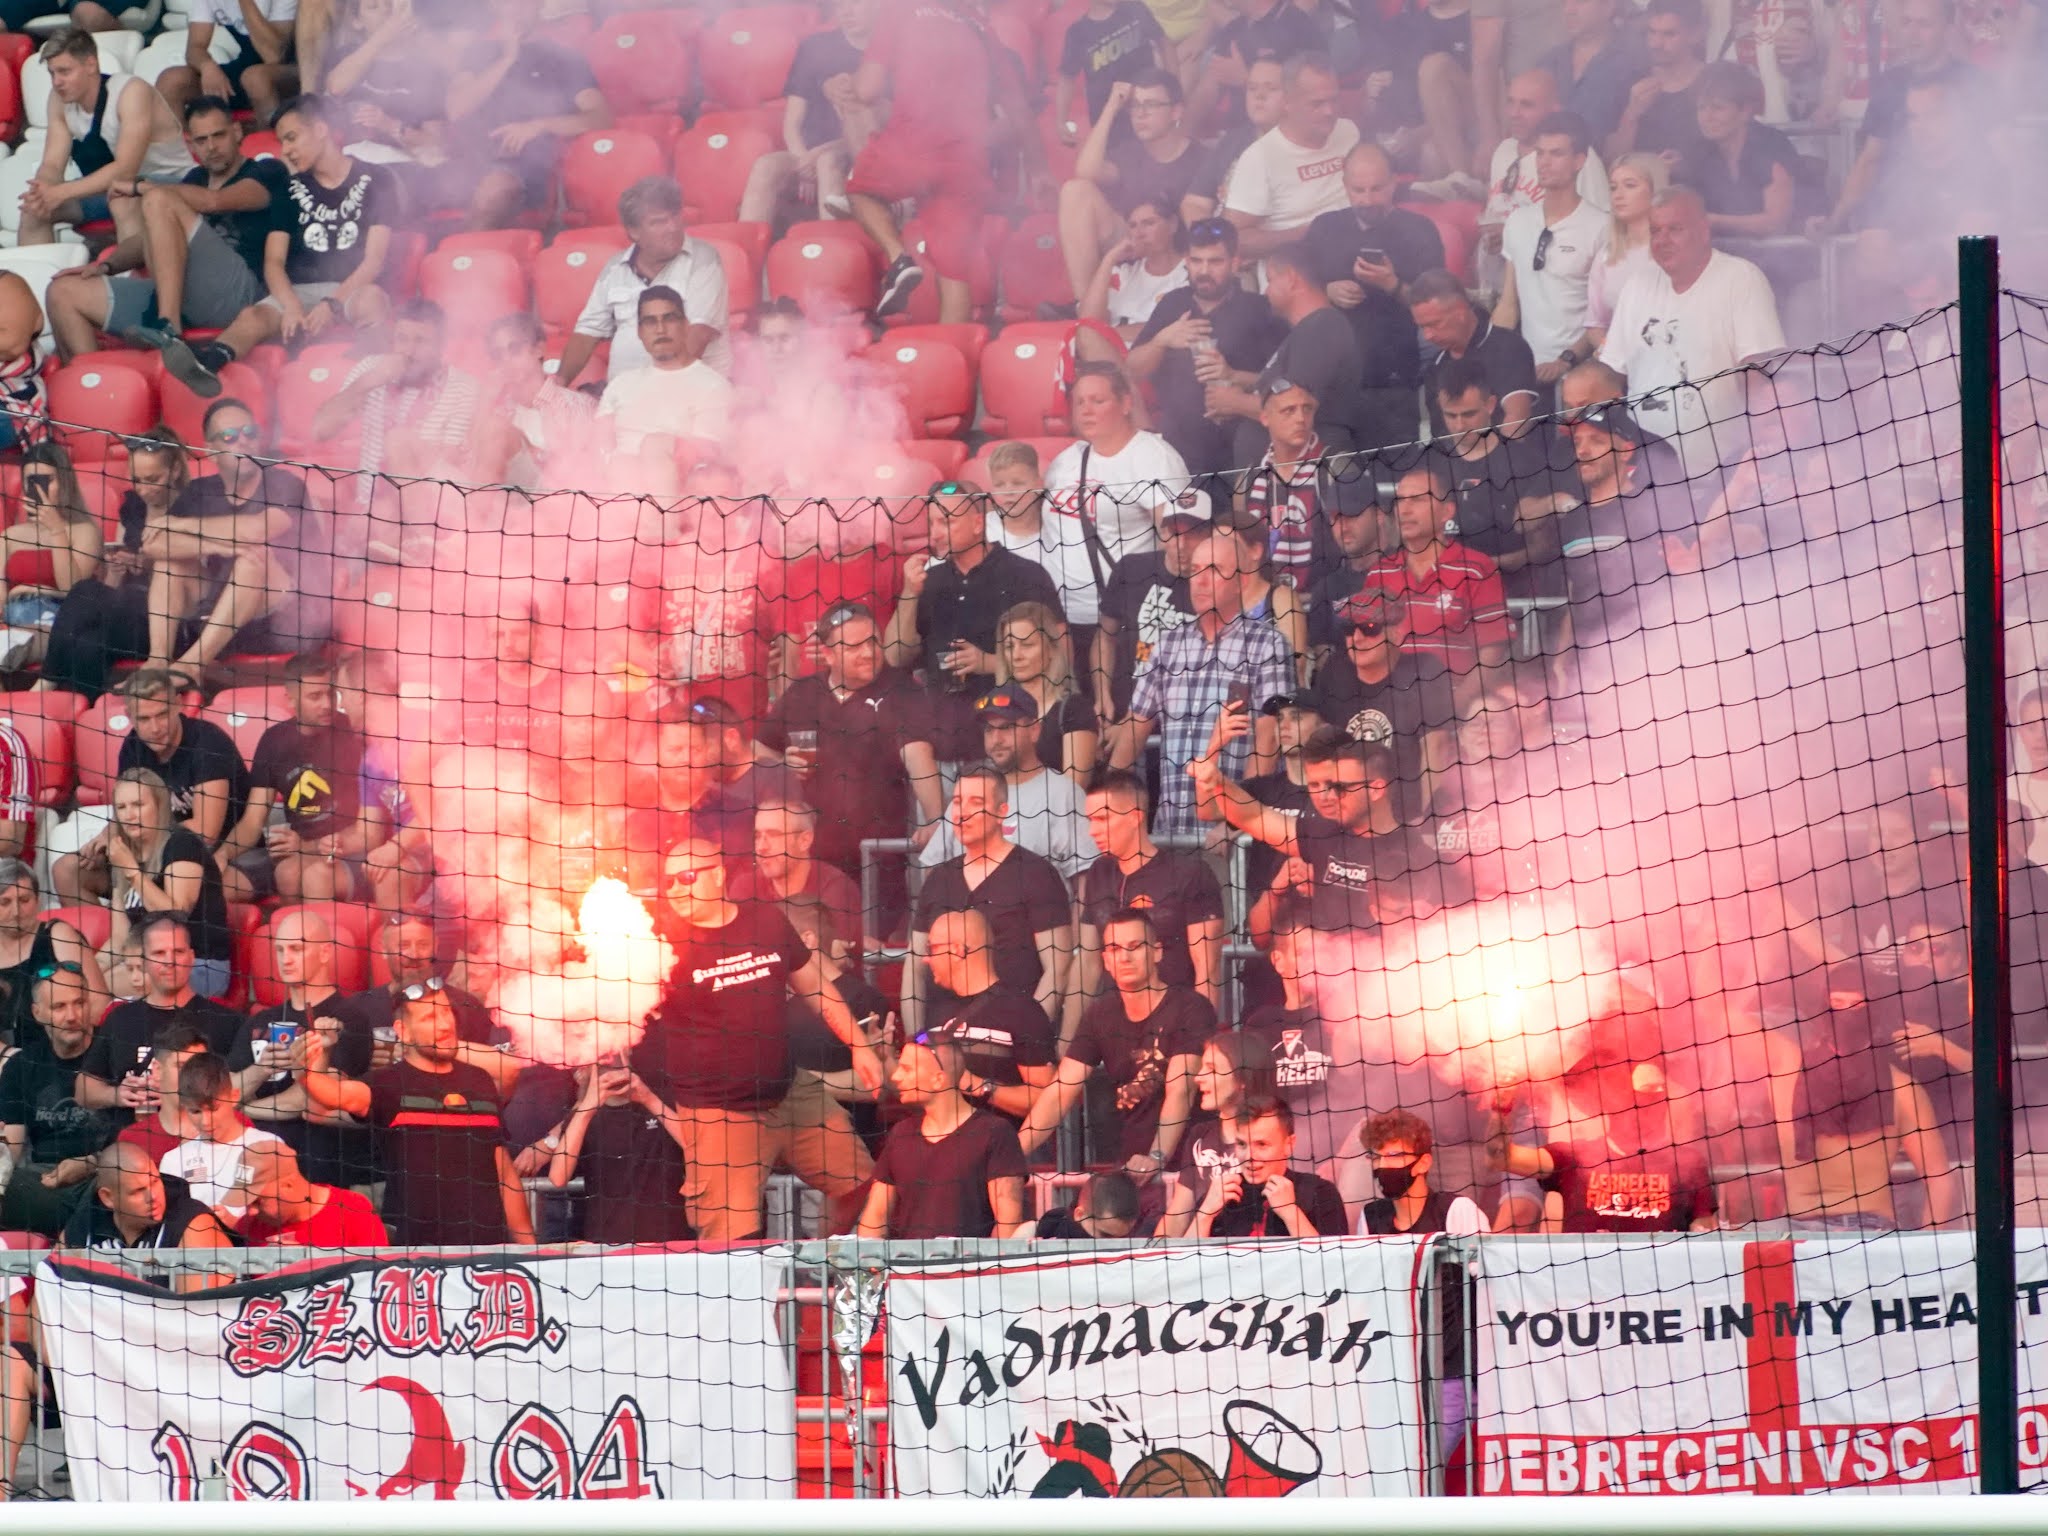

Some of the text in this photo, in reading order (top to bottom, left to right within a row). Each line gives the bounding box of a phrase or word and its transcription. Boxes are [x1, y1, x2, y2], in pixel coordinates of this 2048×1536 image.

[484, 714, 554, 729] HLFIGER
[1586, 1190, 1670, 1212] FIGTERS
[1496, 1279, 2048, 1349] YOU'RE IN MY HEAT
